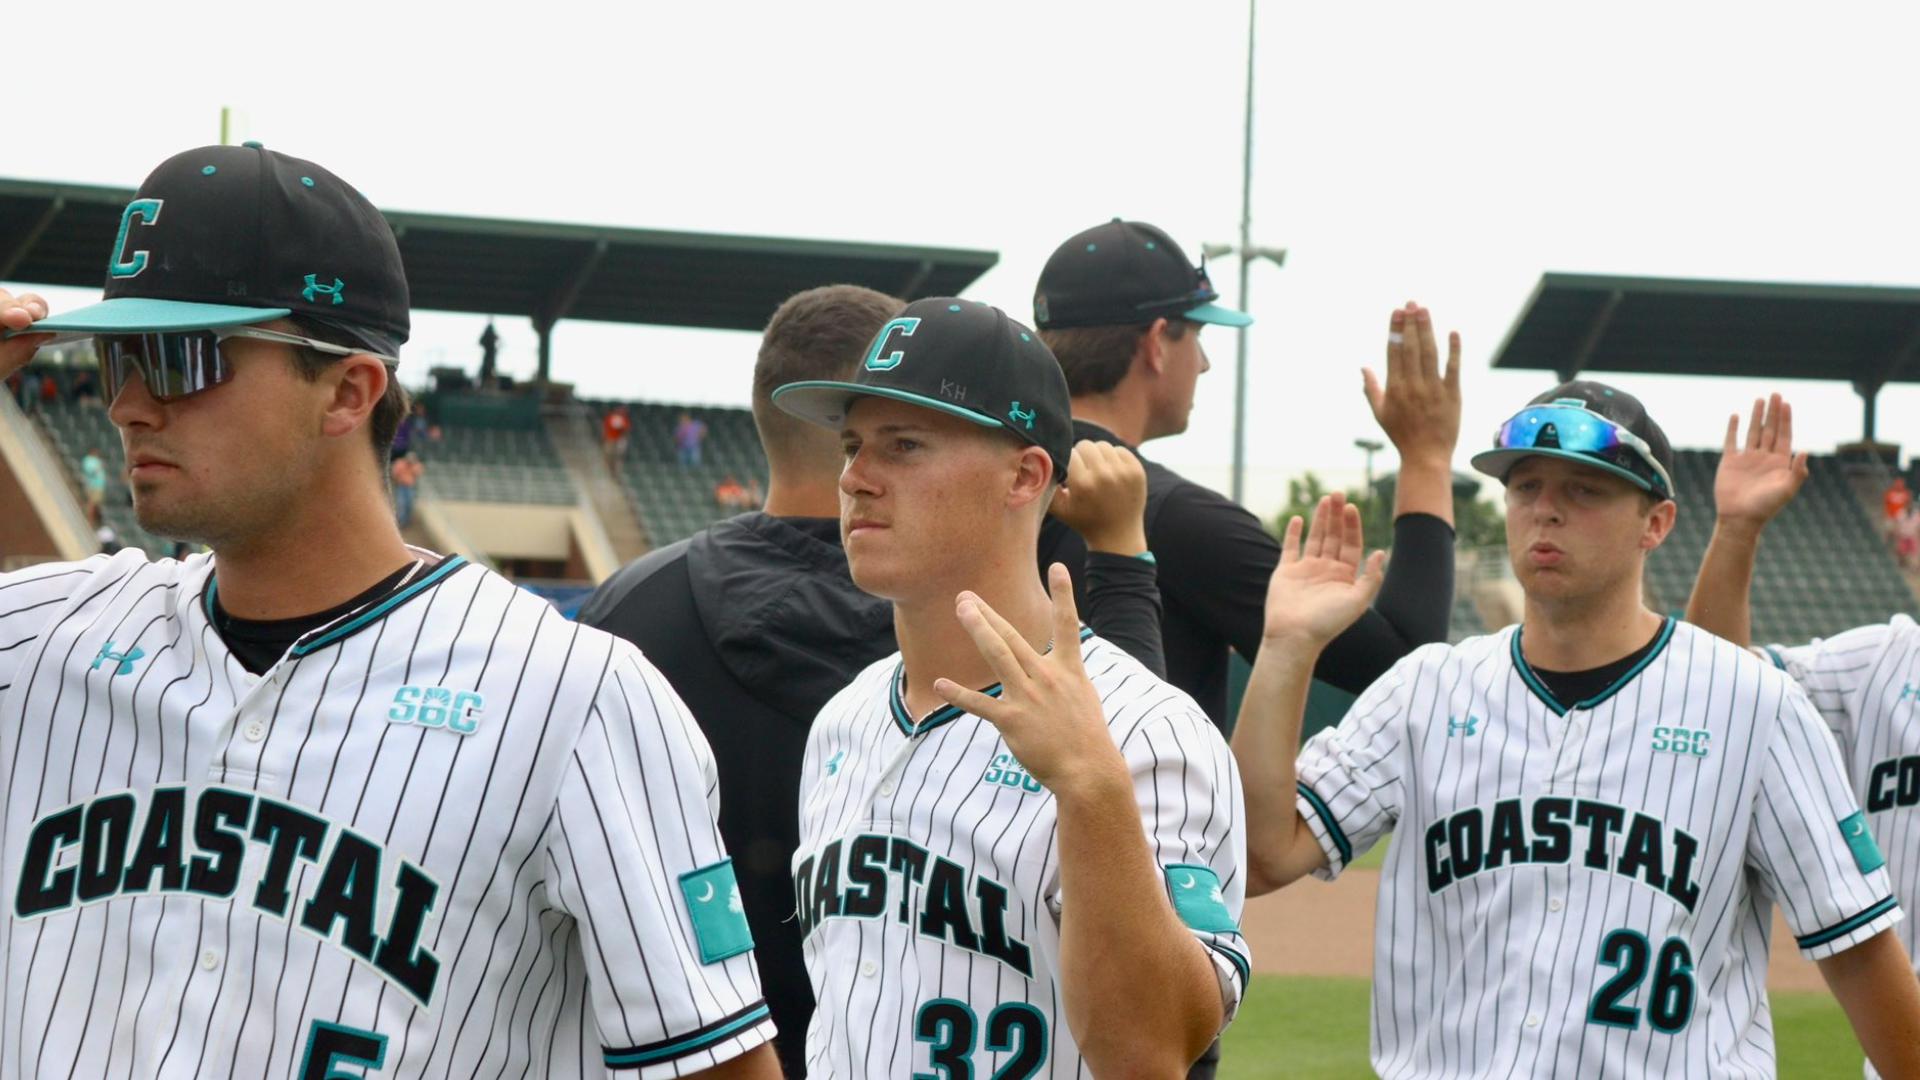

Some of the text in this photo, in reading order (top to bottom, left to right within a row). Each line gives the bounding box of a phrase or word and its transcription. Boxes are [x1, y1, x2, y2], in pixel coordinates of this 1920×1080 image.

[110, 198, 165, 279] C
[865, 317, 922, 371] C
[940, 378, 967, 400] KH
[387, 685, 483, 733] SBC
[1651, 726, 1711, 757] SBC
[13, 785, 443, 1009] COASTAL
[1424, 796, 1701, 916] COASTAL
[797, 834, 1035, 980] OASTAL
[1587, 928, 1695, 1035] 26
[912, 997, 1049, 1080] 32
